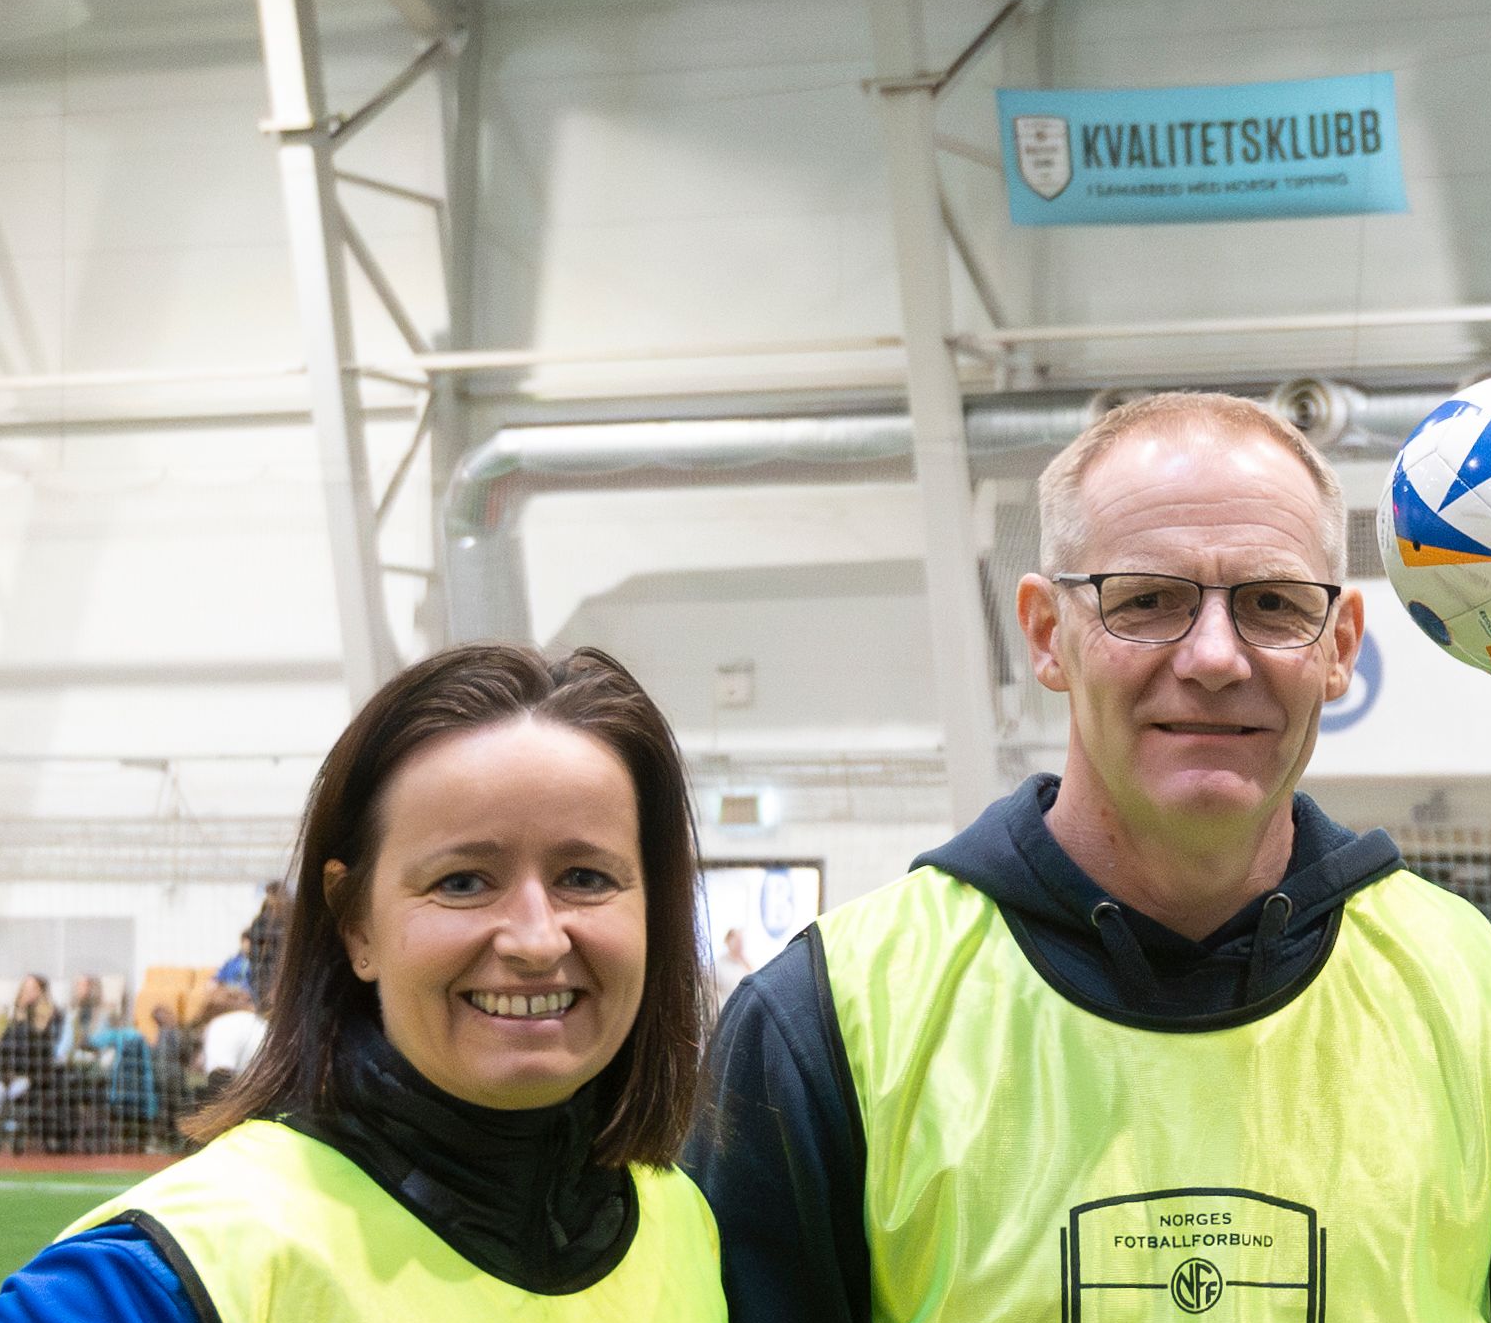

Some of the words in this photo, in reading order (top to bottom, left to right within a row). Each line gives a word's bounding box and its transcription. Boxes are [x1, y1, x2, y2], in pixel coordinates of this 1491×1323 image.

[1081, 108, 1383, 169] KVALITETSKLUBB
[1160, 1212, 1232, 1227] NORGES
[1114, 1234, 1273, 1249] FOTBALLFORBUND
